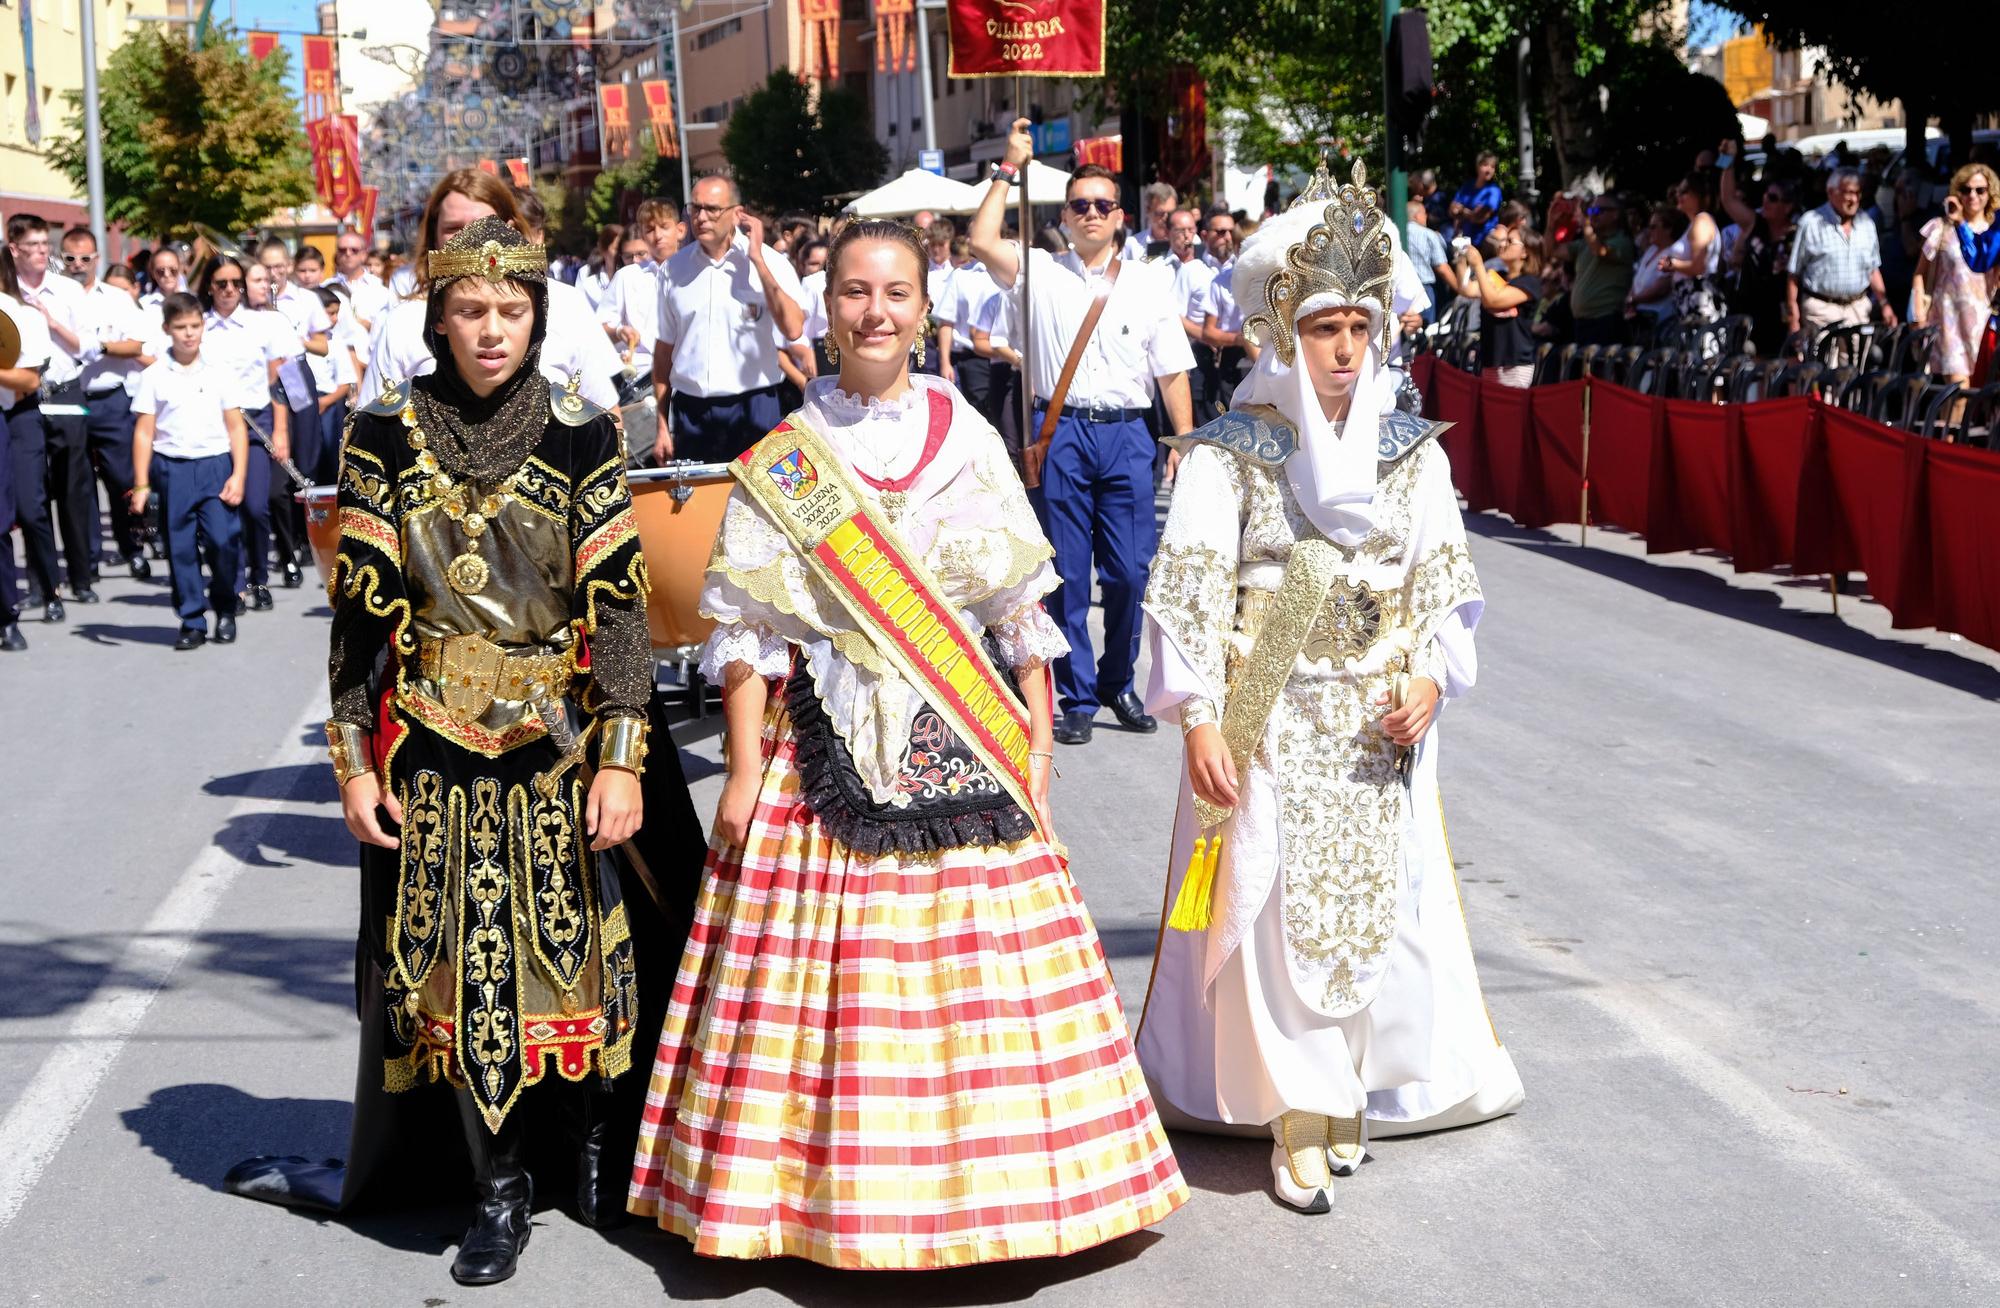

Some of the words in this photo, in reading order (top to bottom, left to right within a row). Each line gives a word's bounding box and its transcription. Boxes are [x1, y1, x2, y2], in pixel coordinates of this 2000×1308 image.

[986, 16, 1065, 40] VILLENA
[1003, 43, 1043, 60] 2022
[791, 482, 838, 519] VILLENA
[802, 493, 841, 527] 2020-21
[816, 507, 841, 530] 2022
[835, 531, 967, 682] REGIDORA
